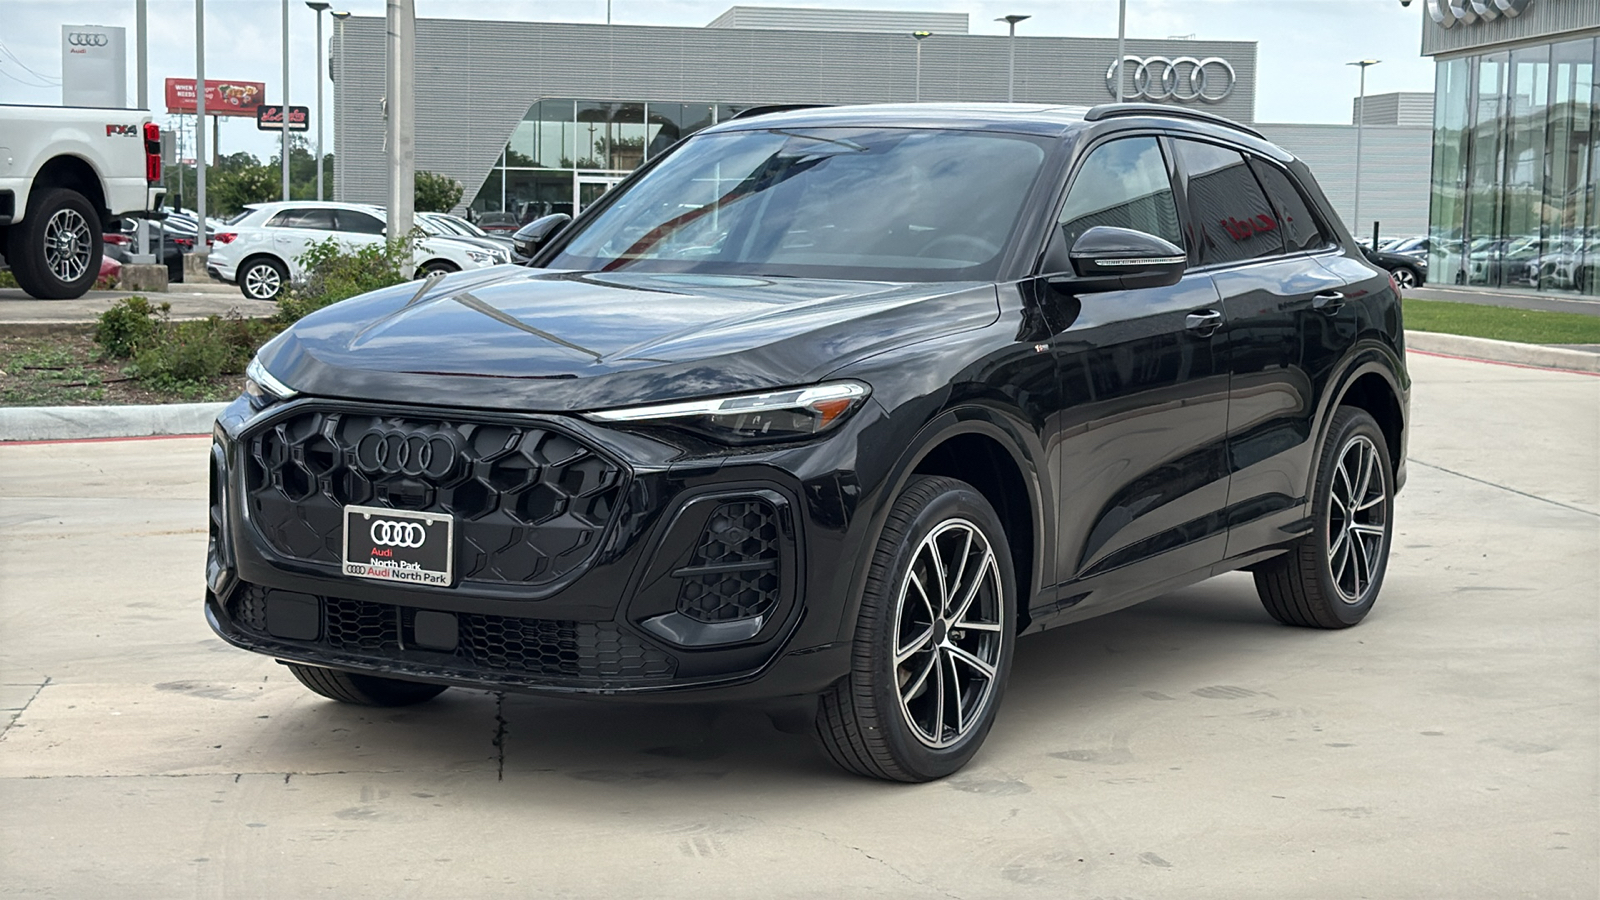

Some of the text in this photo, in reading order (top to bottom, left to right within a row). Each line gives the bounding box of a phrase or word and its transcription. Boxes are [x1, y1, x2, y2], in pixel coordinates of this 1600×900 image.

[106, 124, 138, 137] FX4
[371, 548, 392, 557] Audi
[371, 558, 421, 570] North Park
[367, 567, 446, 584] Audi North Park
